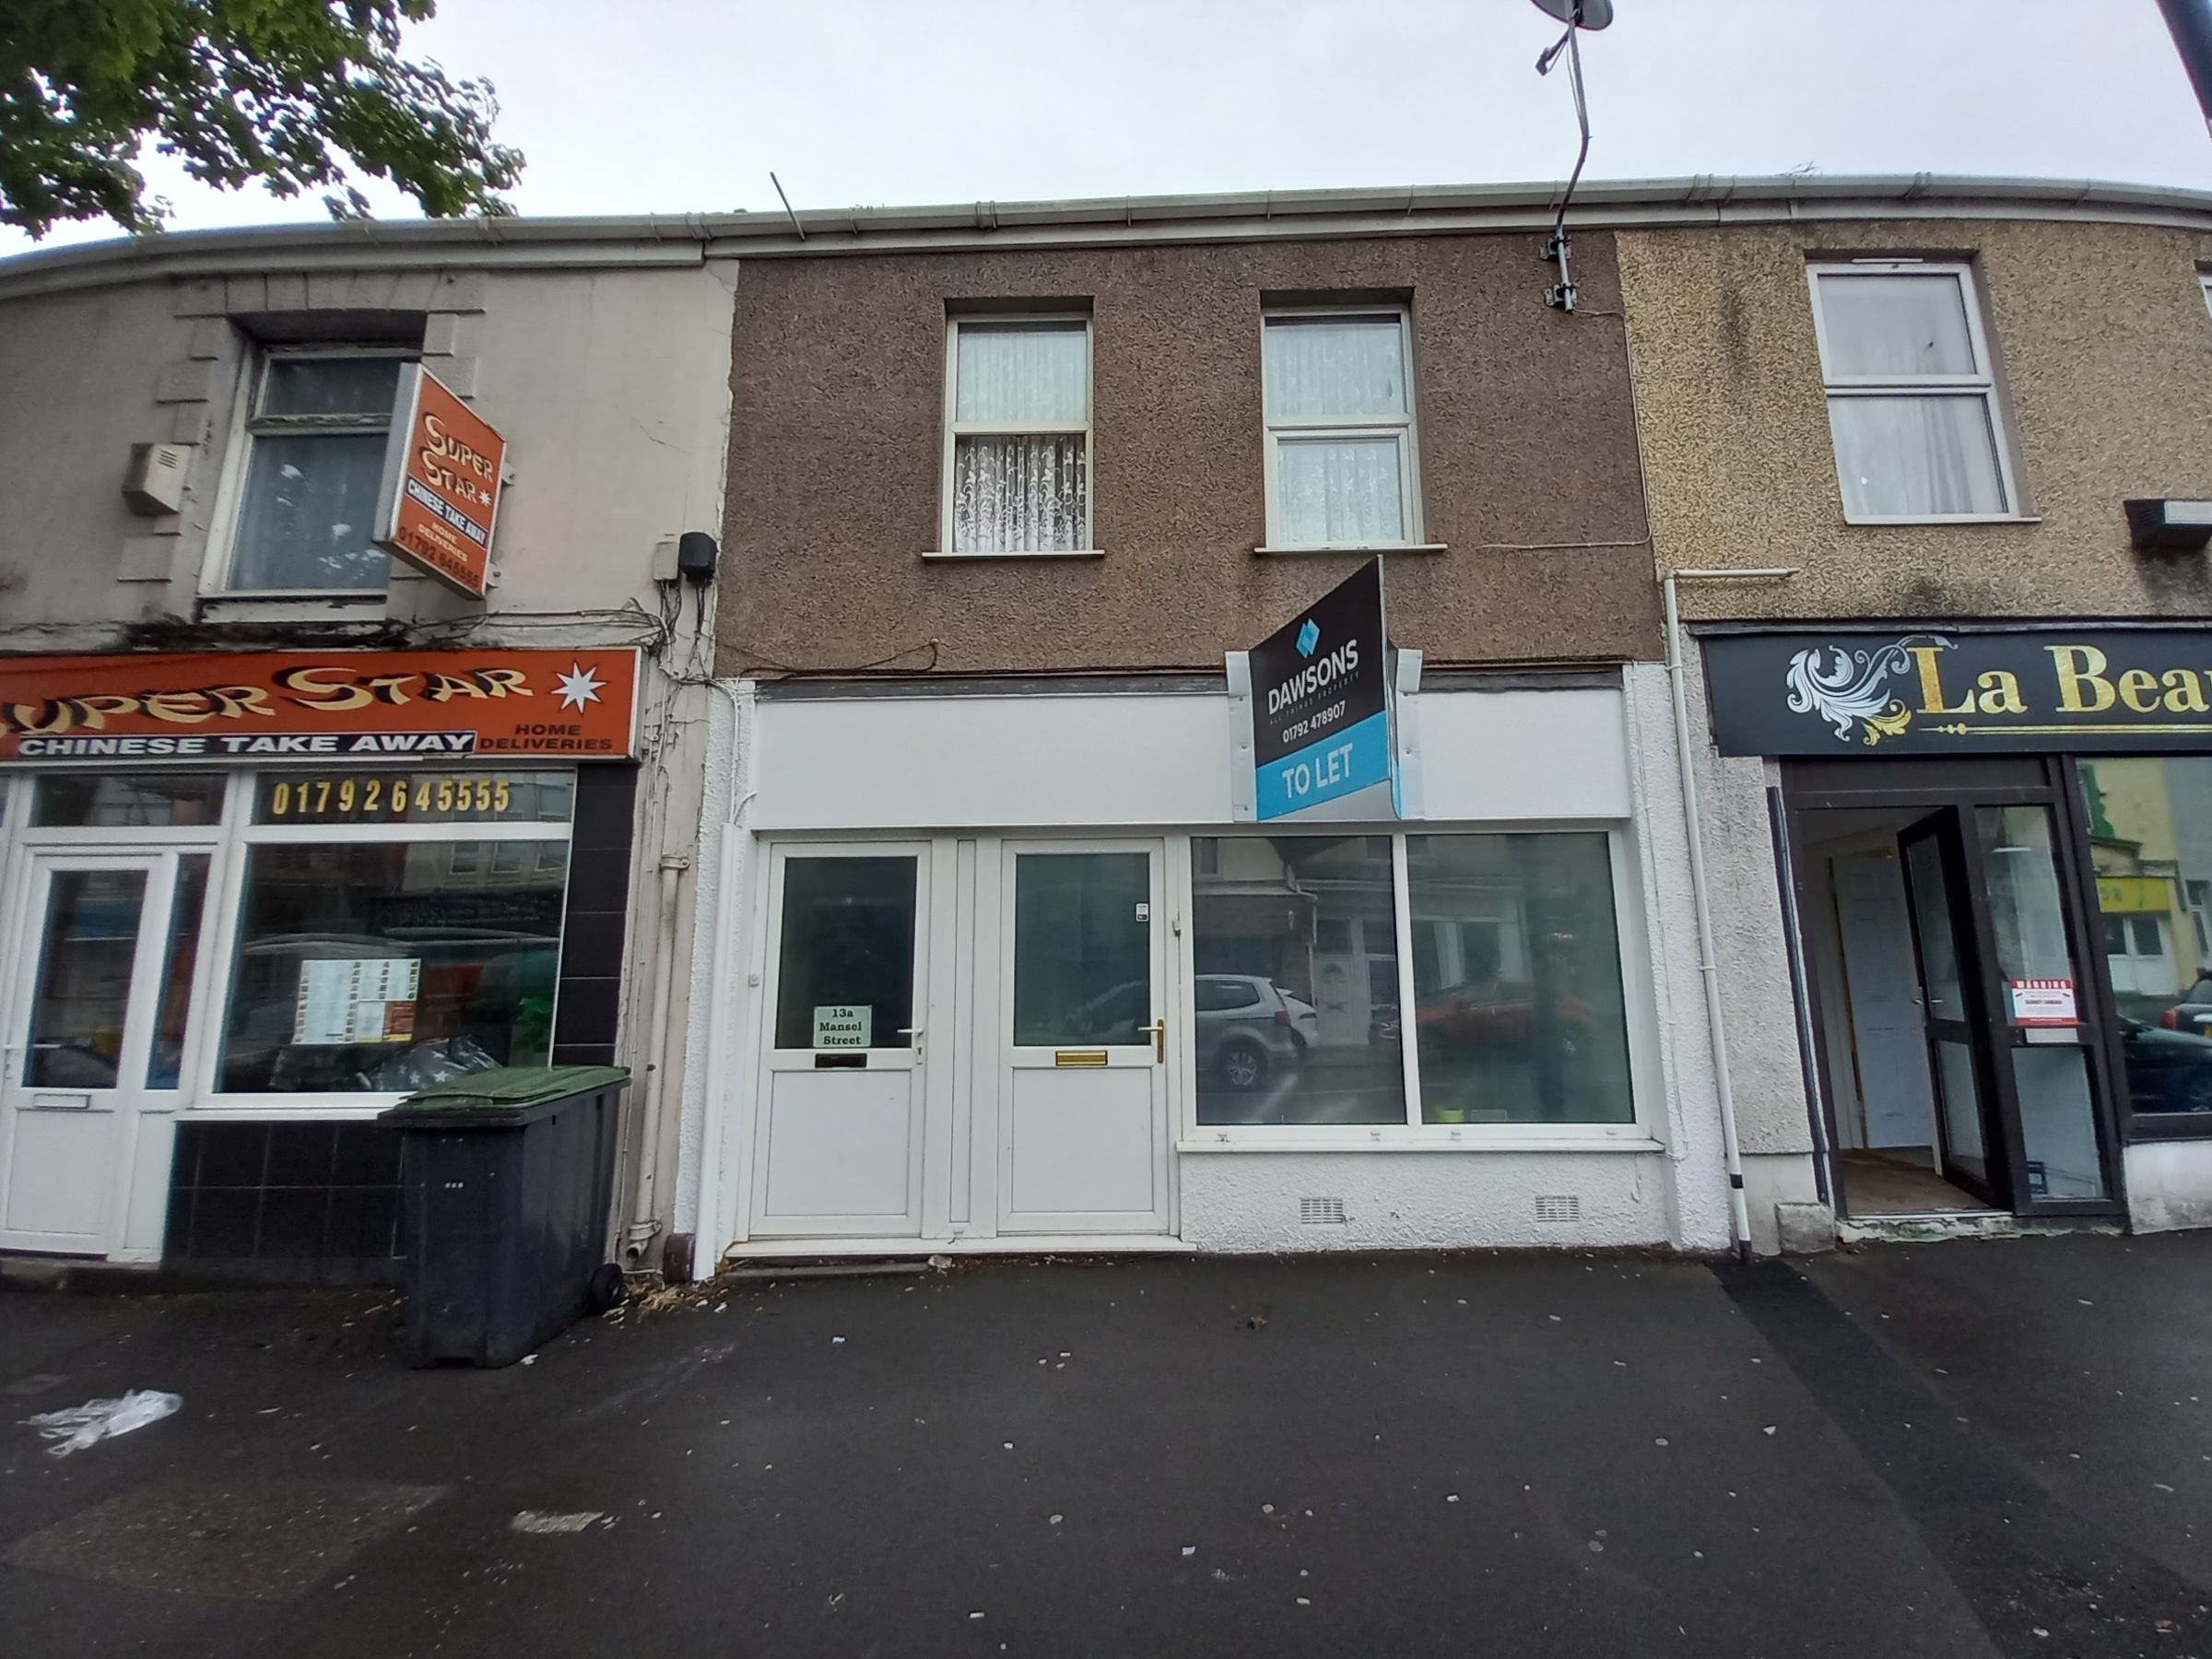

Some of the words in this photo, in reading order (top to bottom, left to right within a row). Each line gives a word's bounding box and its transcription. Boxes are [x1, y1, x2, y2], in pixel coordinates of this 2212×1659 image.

[424, 414, 493, 483] SUPER
[421, 449, 477, 504] STAR
[408, 478, 444, 516] CHINESE
[445, 504, 466, 532] TAKE
[465, 518, 488, 546] AWAY
[398, 526, 436, 560] 01792
[418, 524, 468, 562] DELIVERIES
[431, 522, 457, 545] HOME
[1268, 639, 1359, 715] DAWSONS
[1907, 646, 2028, 714] La
[2043, 645, 2212, 712] Bea
[0, 686, 276, 737] UPER
[278, 665, 535, 712] STAR
[515, 724, 582, 736] HOME
[1282, 720, 1309, 744] 01792
[1310, 700, 1346, 729] 478907
[18, 738, 206, 756] CHINESE
[220, 735, 339, 753] TAKE
[348, 734, 475, 752] AWAY
[479, 737, 614, 751] DELIVERIES
[1282, 763, 1310, 798] TO
[1315, 742, 1353, 789] LET
[819, 1021, 863, 1031] Mansel
[832, 1008, 853, 1018] 13a
[823, 1035, 862, 1045] Street
